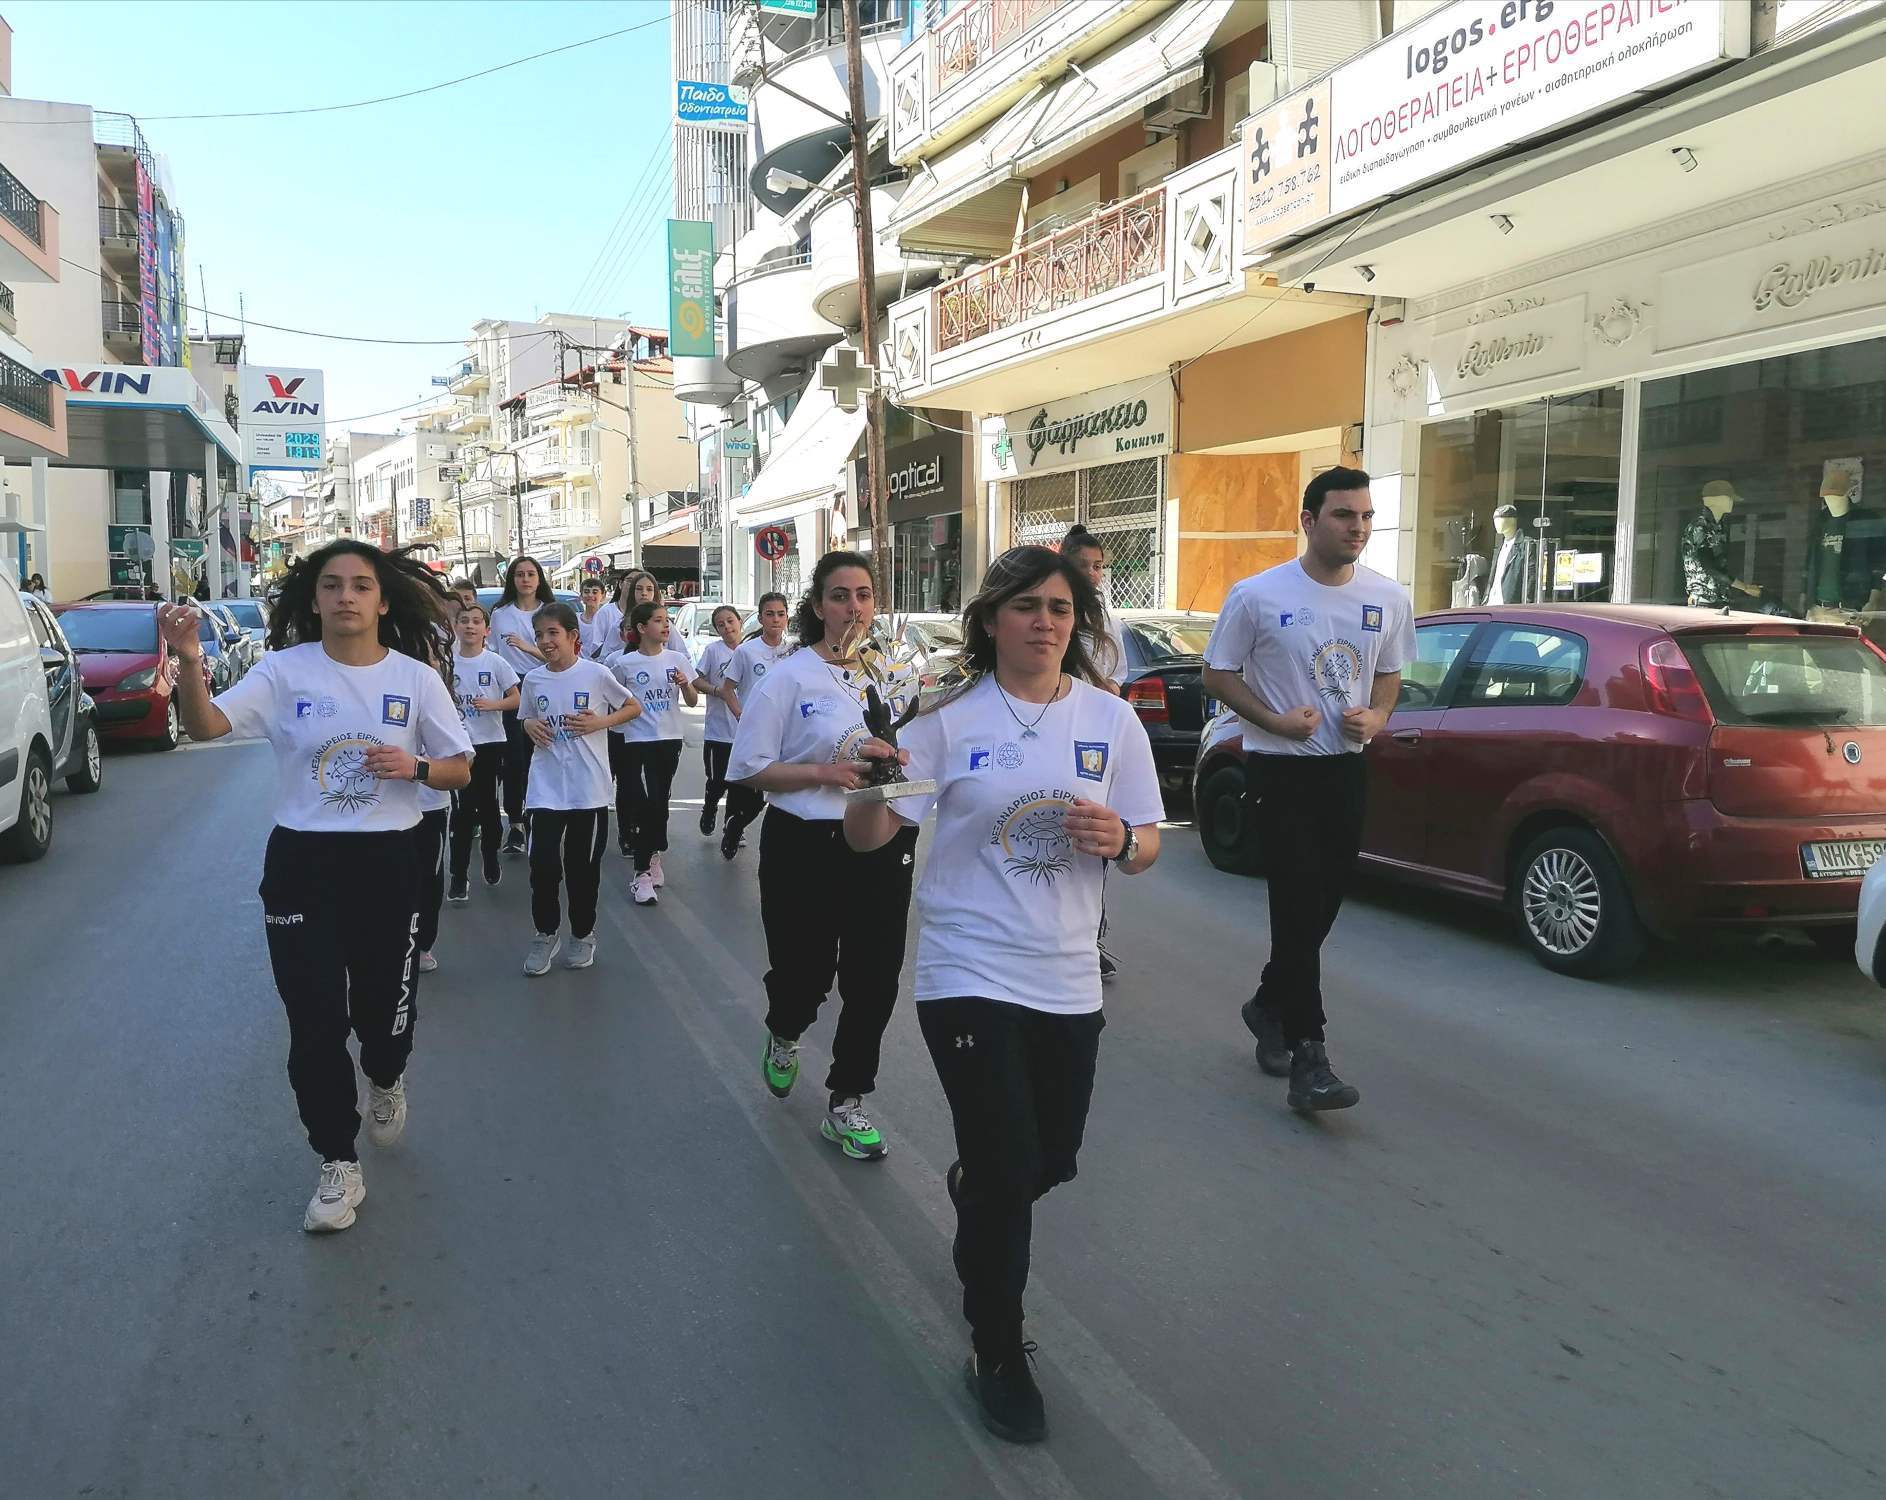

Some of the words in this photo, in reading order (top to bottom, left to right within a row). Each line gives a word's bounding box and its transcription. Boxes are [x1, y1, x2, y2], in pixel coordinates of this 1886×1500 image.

[1503, 0, 1688, 84] ΕΡΓΟΘΕΡΑΠ
[1432, 106, 1498, 143] συμβουλευτική
[1500, 90, 1535, 115] γονέων
[1545, 52, 1615, 92] αισθητηριακή
[1617, 21, 1693, 61] ολοκλήρωση
[681, 86, 725, 102] Παιδο
[41, 368, 151, 395] AVIN
[252, 401, 319, 415] AVIN
[725, 442, 751, 450] WIND
[357, 732, 385, 746] ΕΙΡΗΝ
[1052, 788, 1080, 804] ΕΙΡΗ
[1818, 841, 1886, 868] NHK-59
